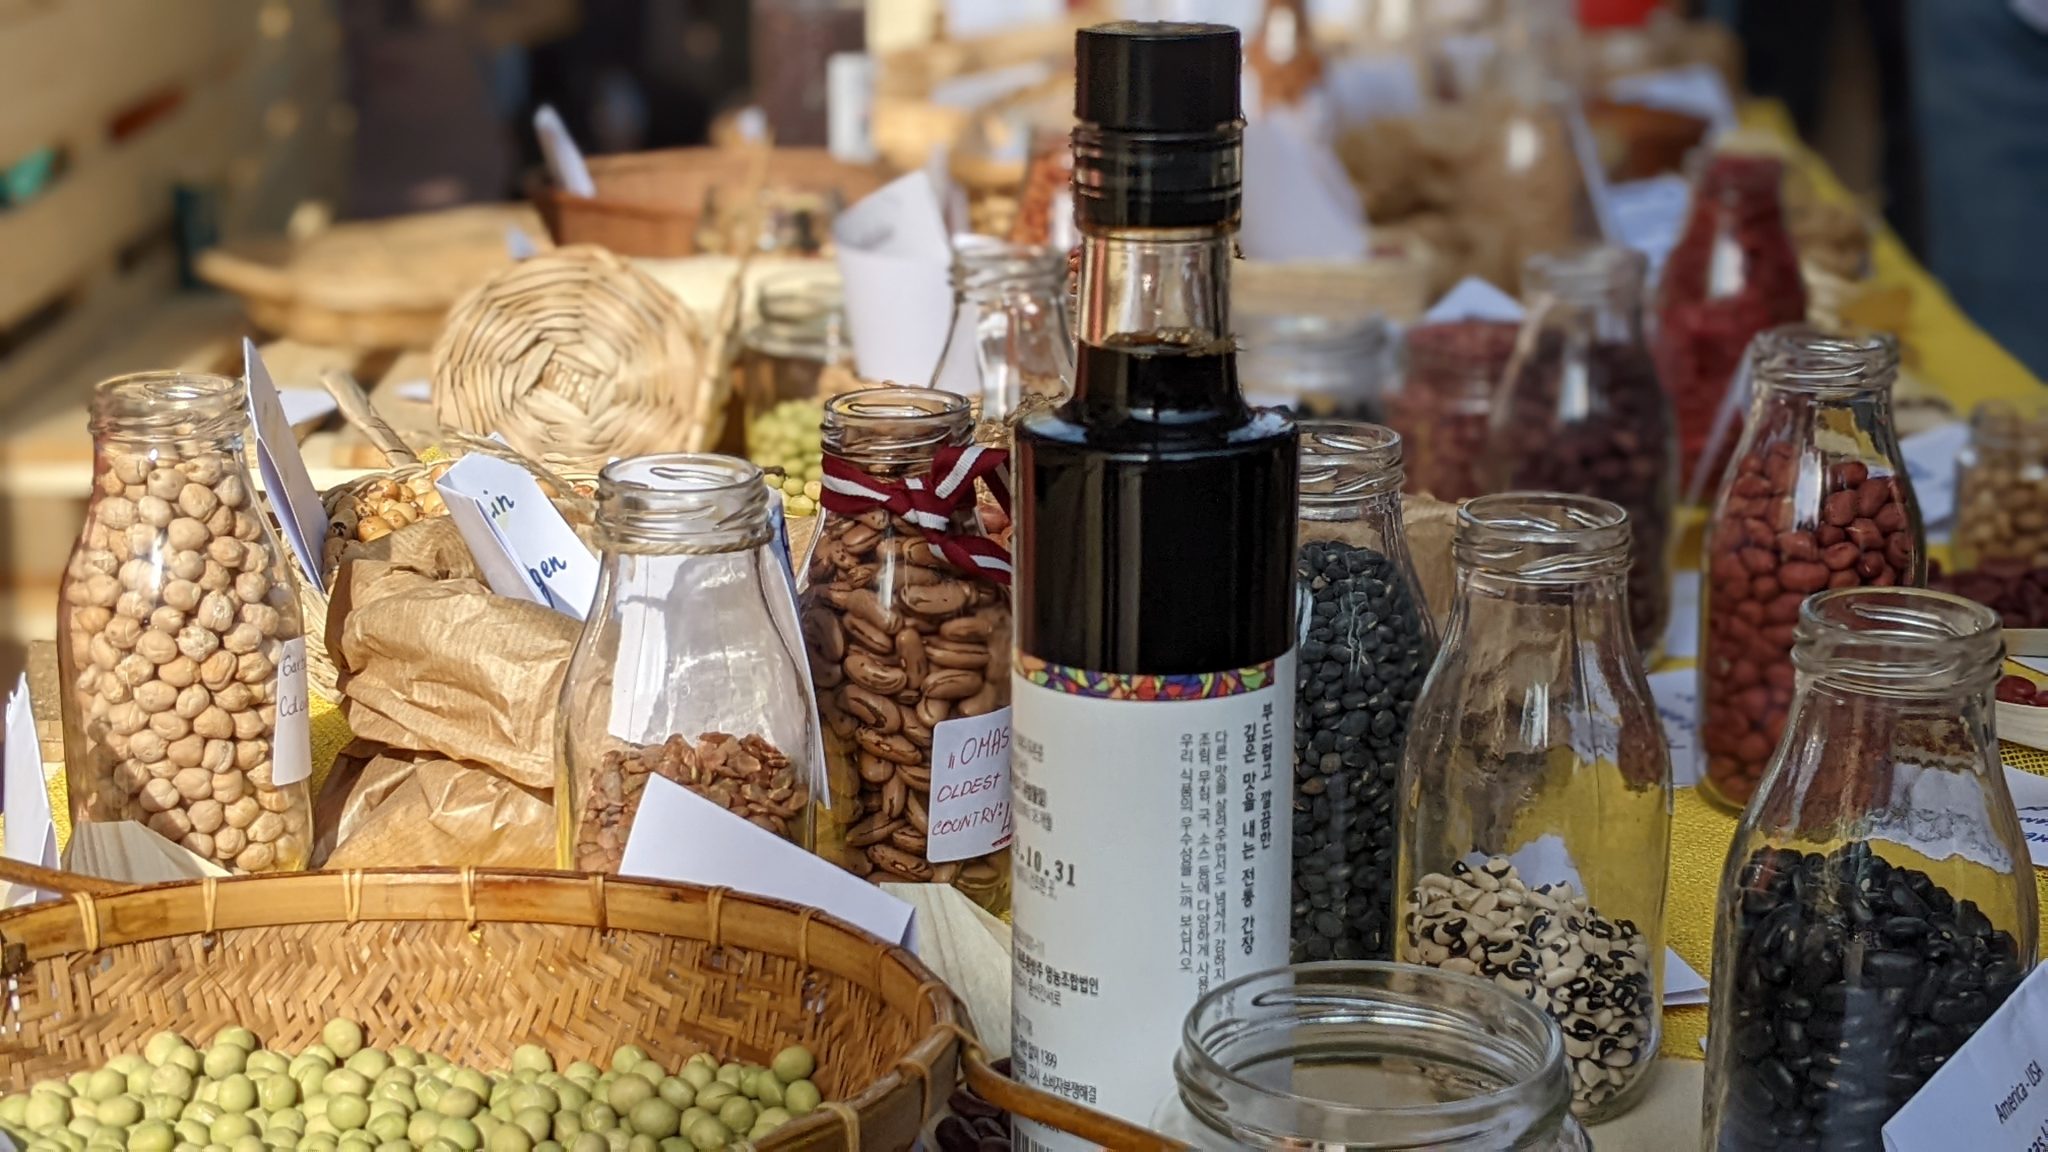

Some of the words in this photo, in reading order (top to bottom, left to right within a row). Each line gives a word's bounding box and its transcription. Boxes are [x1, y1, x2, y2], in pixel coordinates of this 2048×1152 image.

[1179, 733, 1193, 763] 우리
[1242, 721, 1257, 764] 깊은
[1242, 770, 1257, 813] 맛을
[1197, 832, 1210, 862] 소스
[1242, 818, 1256, 861] 내는
[1240, 866, 1255, 908] 전통
[1196, 898, 1210, 958] 다양하게
[1240, 914, 1255, 956] 간장
[1044, 964, 1099, 996] 영농조합법인
[1995, 1083, 2029, 1125] America
[2024, 1059, 2045, 1087] USA
